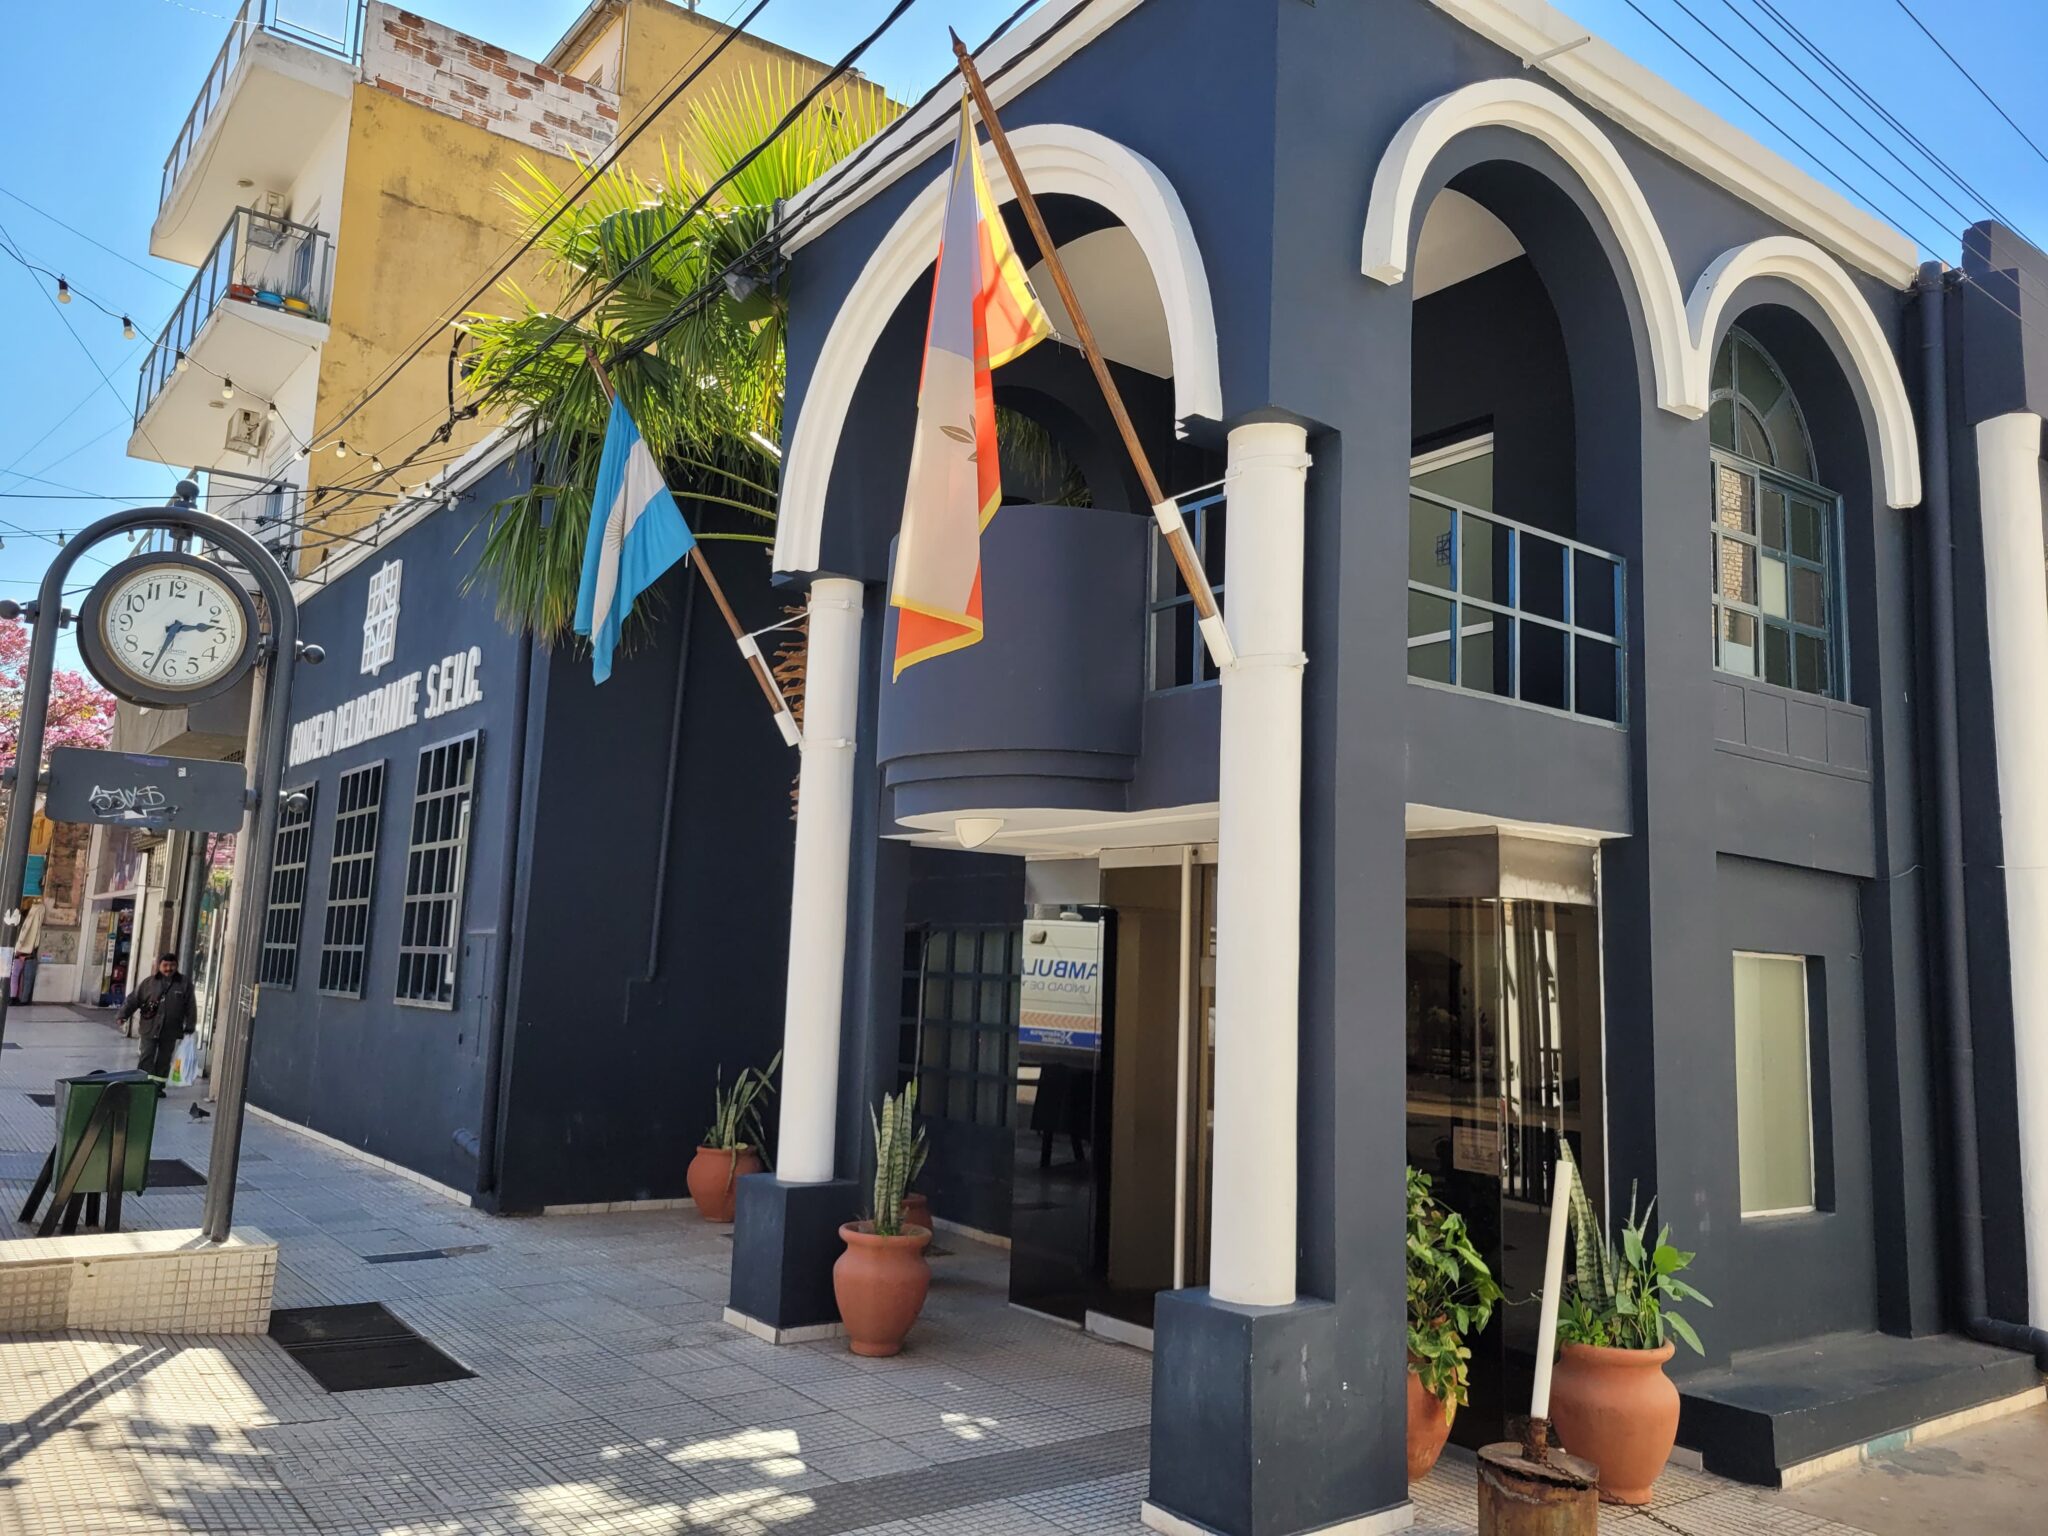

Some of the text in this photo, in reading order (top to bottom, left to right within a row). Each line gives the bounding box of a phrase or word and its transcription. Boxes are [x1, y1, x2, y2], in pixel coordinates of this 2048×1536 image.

[148, 583, 160, 600] 11
[169, 580, 187, 599] 12
[198, 590, 204, 607] 1
[127, 594, 145, 612] 10
[119, 614, 133, 631] 9
[209, 605, 222, 624] 2
[124, 635, 138, 653] 8
[213, 626, 226, 644] 3
[142, 651, 155, 669] 7
[202, 646, 219, 662] 4
[163, 659, 177, 677] 6
[186, 656, 199, 675] 5
[334, 671, 422, 752] DELIBERANTE
